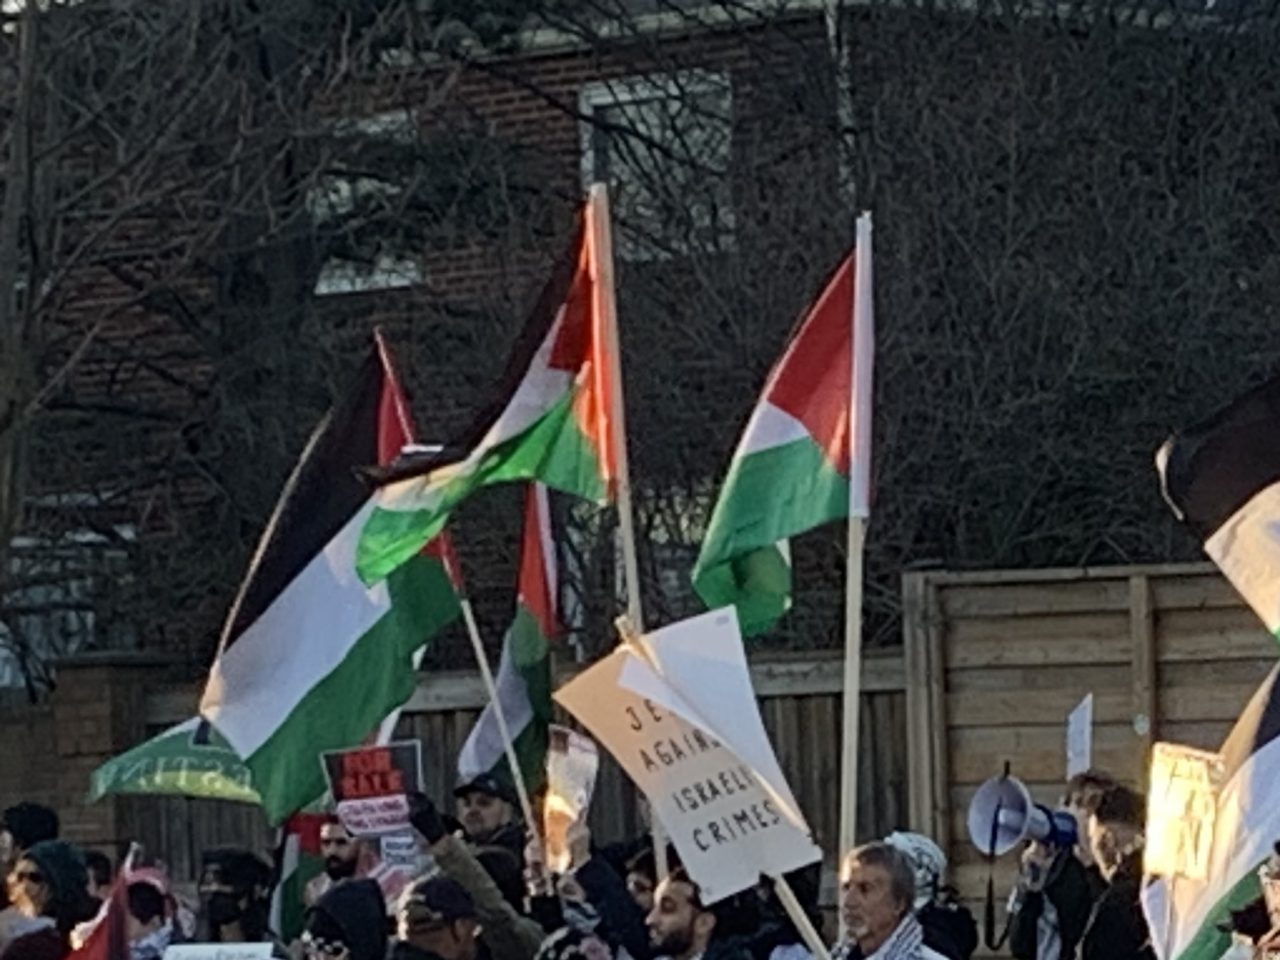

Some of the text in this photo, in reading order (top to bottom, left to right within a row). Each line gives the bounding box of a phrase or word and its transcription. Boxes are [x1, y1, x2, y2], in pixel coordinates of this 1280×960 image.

[625, 698, 674, 732] JE
[639, 727, 723, 773] AGAIN
[671, 763, 754, 813] ISRAELI
[692, 798, 780, 852] CRIMES
